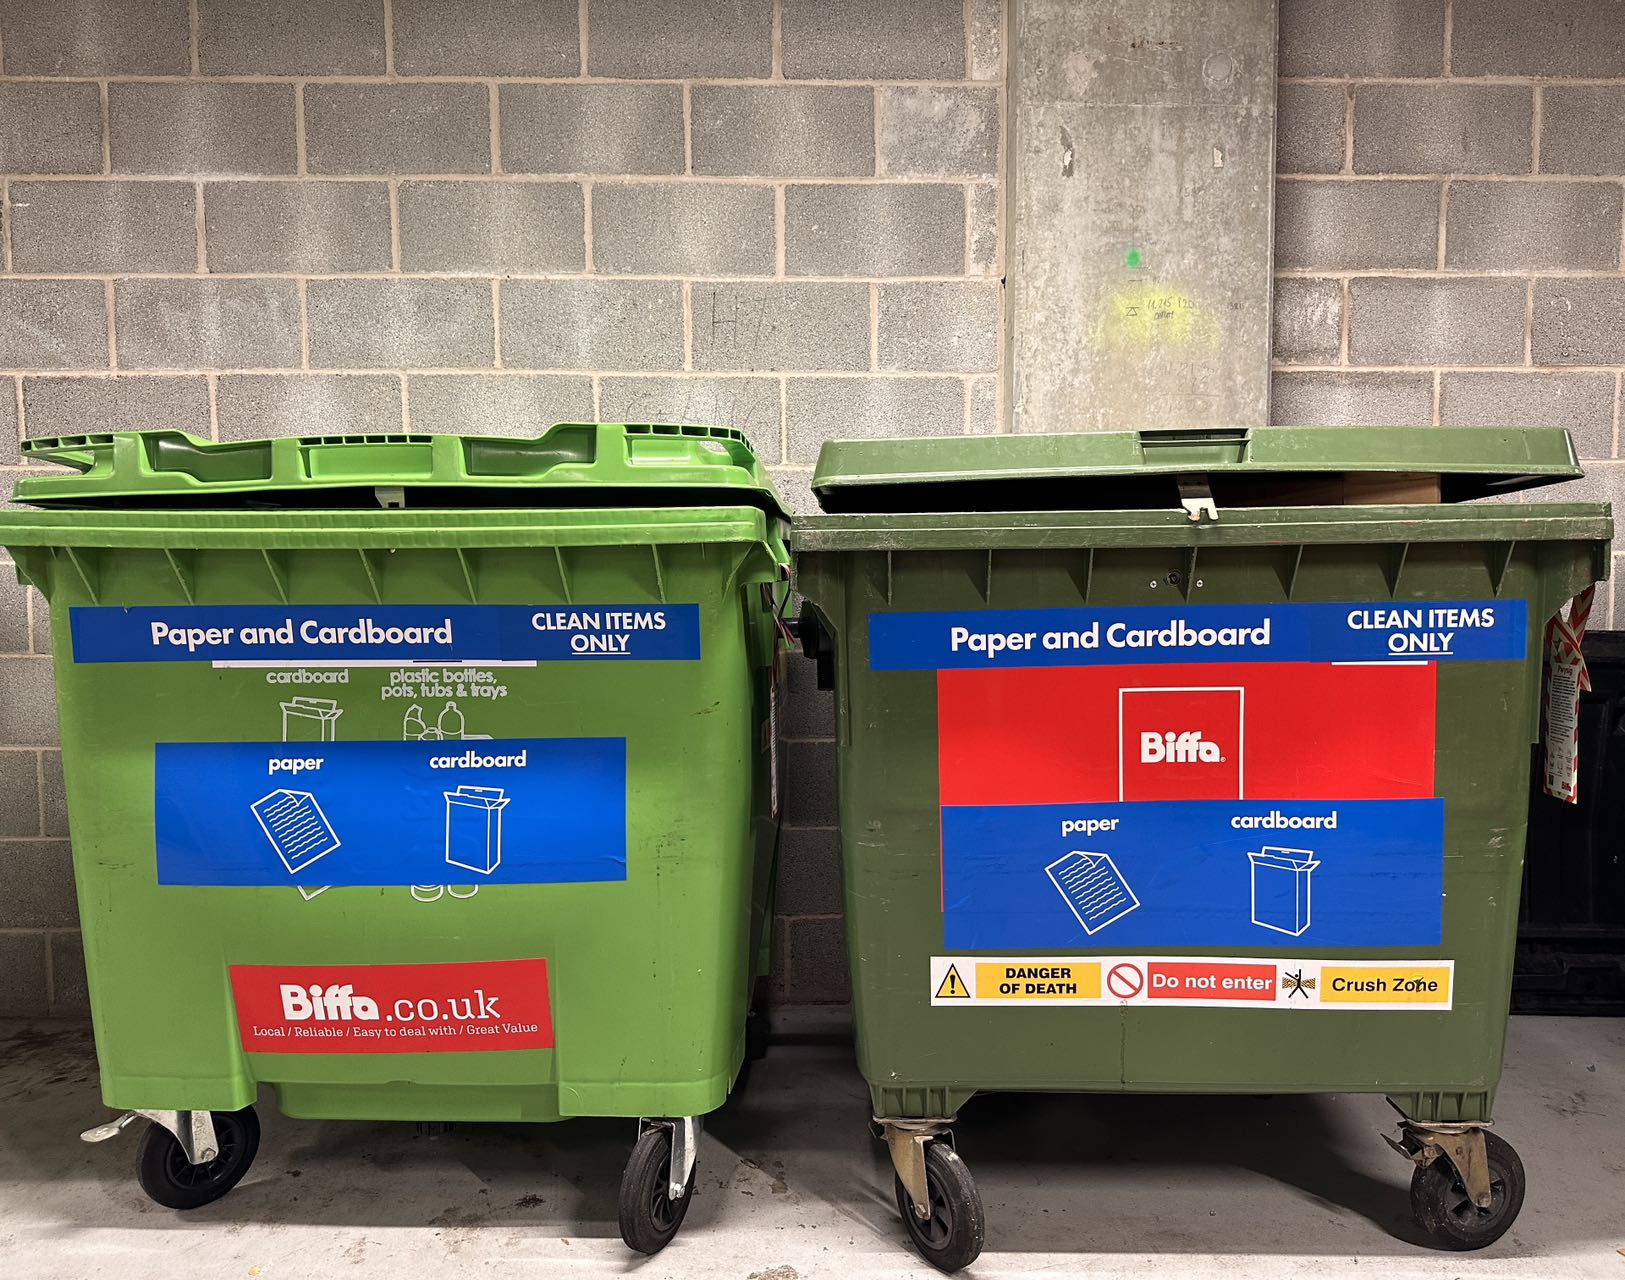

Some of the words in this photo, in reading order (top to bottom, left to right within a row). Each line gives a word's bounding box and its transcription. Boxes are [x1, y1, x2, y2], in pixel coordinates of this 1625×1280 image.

[531, 612, 601, 631] CLEAN
[605, 611, 666, 630] ITEMS
[1347, 610, 1423, 630] CLEAN
[1428, 608, 1495, 628] ITEMS
[151, 621, 234, 652] Paper
[239, 618, 294, 645] and
[299, 618, 453, 644] Cardboard
[951, 627, 1037, 659] Paper
[1042, 622, 1099, 650] and
[1106, 618, 1271, 648] Cardboard
[1388, 632, 1455, 656] ONLY
[571, 634, 631, 655] ONLY
[266, 668, 349, 684] cardboard
[390, 669, 439, 686] plastic
[443, 668, 497, 684] bottles,
[382, 685, 417, 700] pots,
[421, 683, 452, 698] tubs
[456, 684, 468, 697] &
[471, 683, 508, 700] trays
[268, 758, 324, 776] paper
[429, 749, 527, 769] cardboard
[1061, 818, 1120, 837] paper
[1230, 810, 1338, 829] cardboard
[1005, 967, 1072, 979] DANGER
[1152, 973, 1179, 988] Do
[1185, 975, 1217, 989] not
[1221, 976, 1273, 990] enter
[999, 983, 1021, 995] OF
[1025, 983, 1077, 995] DEATH
[1331, 977, 1387, 992] Crush
[1392, 978, 1438, 993] Zone
[253, 1026, 285, 1037] Local
[294, 1026, 343, 1038] Reliable
[353, 1026, 383, 1039] Easy
[384, 1027, 397, 1037] to
[399, 1026, 426, 1037] deal
[428, 1025, 456, 1036] with
[466, 1023, 500, 1035] Great
[501, 1022, 538, 1034] Value
